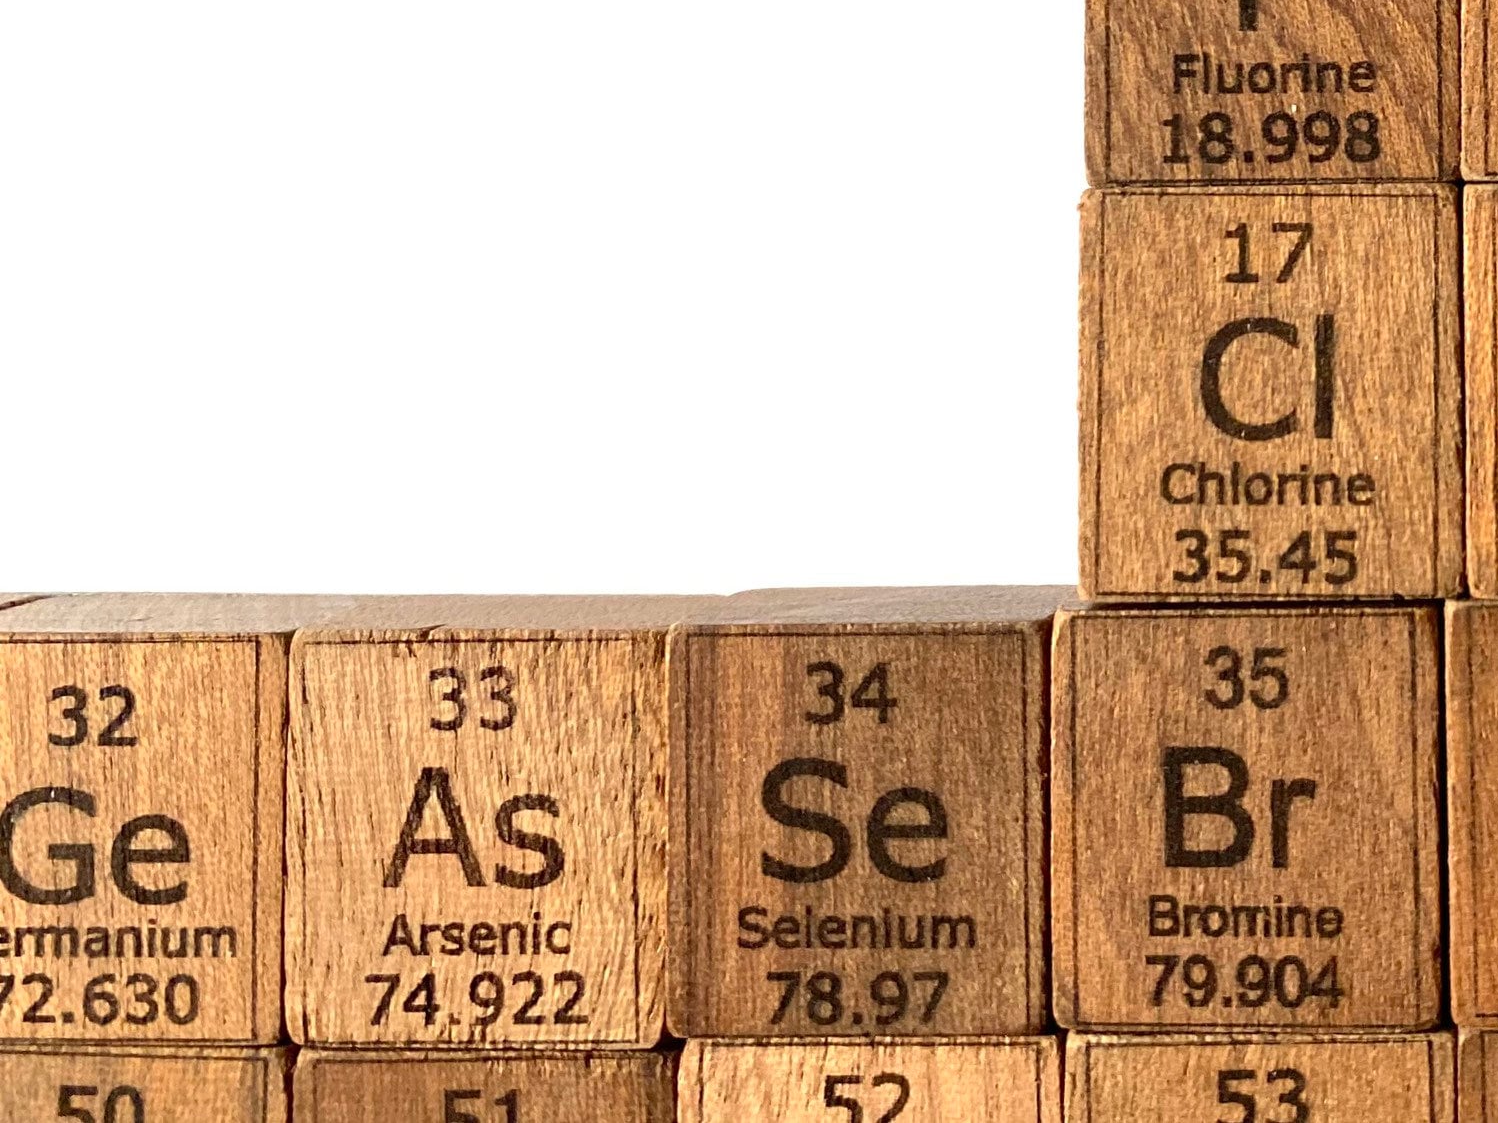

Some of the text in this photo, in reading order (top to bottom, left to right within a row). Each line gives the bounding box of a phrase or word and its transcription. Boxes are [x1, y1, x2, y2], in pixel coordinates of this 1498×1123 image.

[1172, 53, 1376, 95] Fluorine
[1162, 112, 1382, 166] 18.998
[1223, 222, 1315, 284] 17
[1201, 313, 1335, 442] Cl
[1161, 462, 1376, 508] Chlorine
[1171, 529, 1359, 585] 35.45
[428, 666, 518, 731] 33
[805, 660, 898, 725] 34
[1205, 646, 1289, 710] 35
[46, 684, 138, 747] 32
[382, 766, 565, 890] As
[761, 756, 948, 883] Se
[1162, 745, 1316, 869] Br
[0, 786, 191, 905] Ge
[382, 912, 572, 957] Arsenic
[737, 904, 976, 950] Selenium
[1148, 894, 1343, 939] Bromine
[365, 970, 588, 1027] 74.922
[767, 971, 949, 1026] 78.97
[1146, 954, 1345, 1009] 79.904
[56, 1085, 145, 1123] 50
[824, 1075, 911, 1123] 52
[1216, 1068, 1308, 1123] 53
